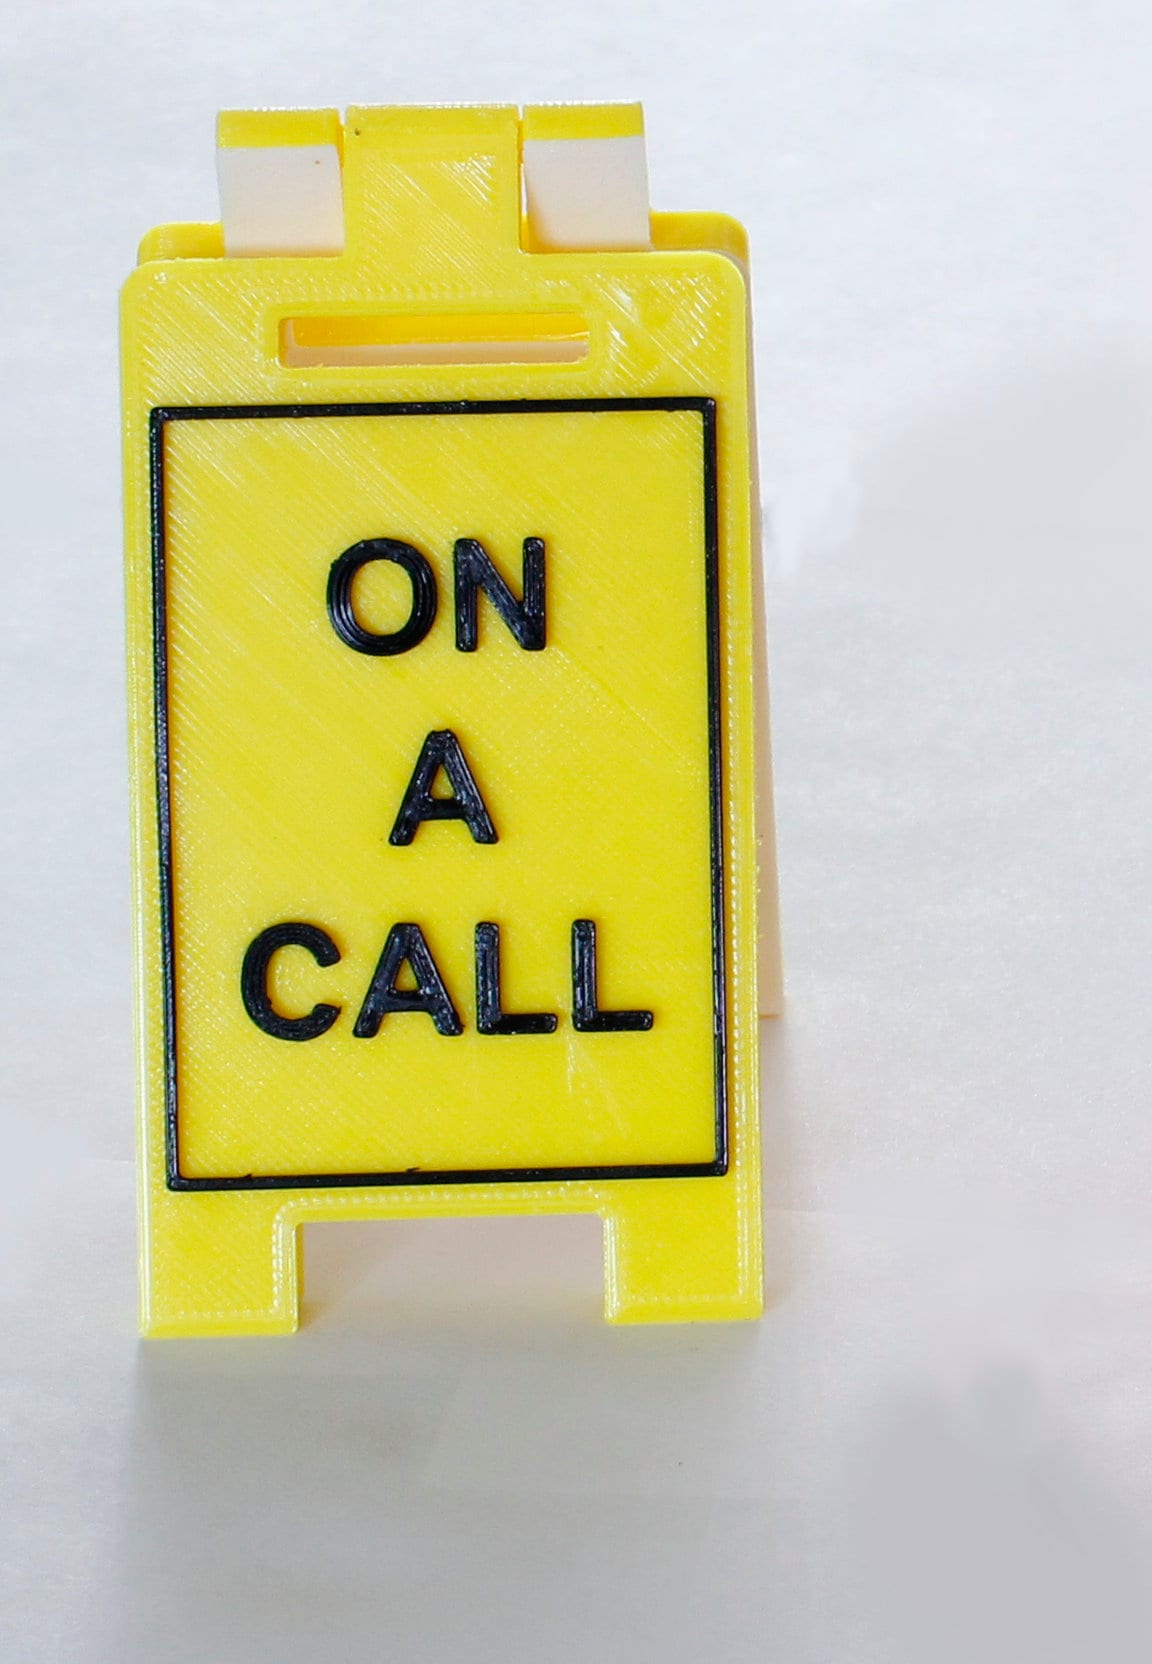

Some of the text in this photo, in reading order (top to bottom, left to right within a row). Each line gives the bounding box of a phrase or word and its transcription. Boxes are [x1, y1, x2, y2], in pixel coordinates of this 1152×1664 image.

[327, 536, 547, 656] ON
[388, 729, 499, 846] A
[241, 919, 654, 1041] CALL
